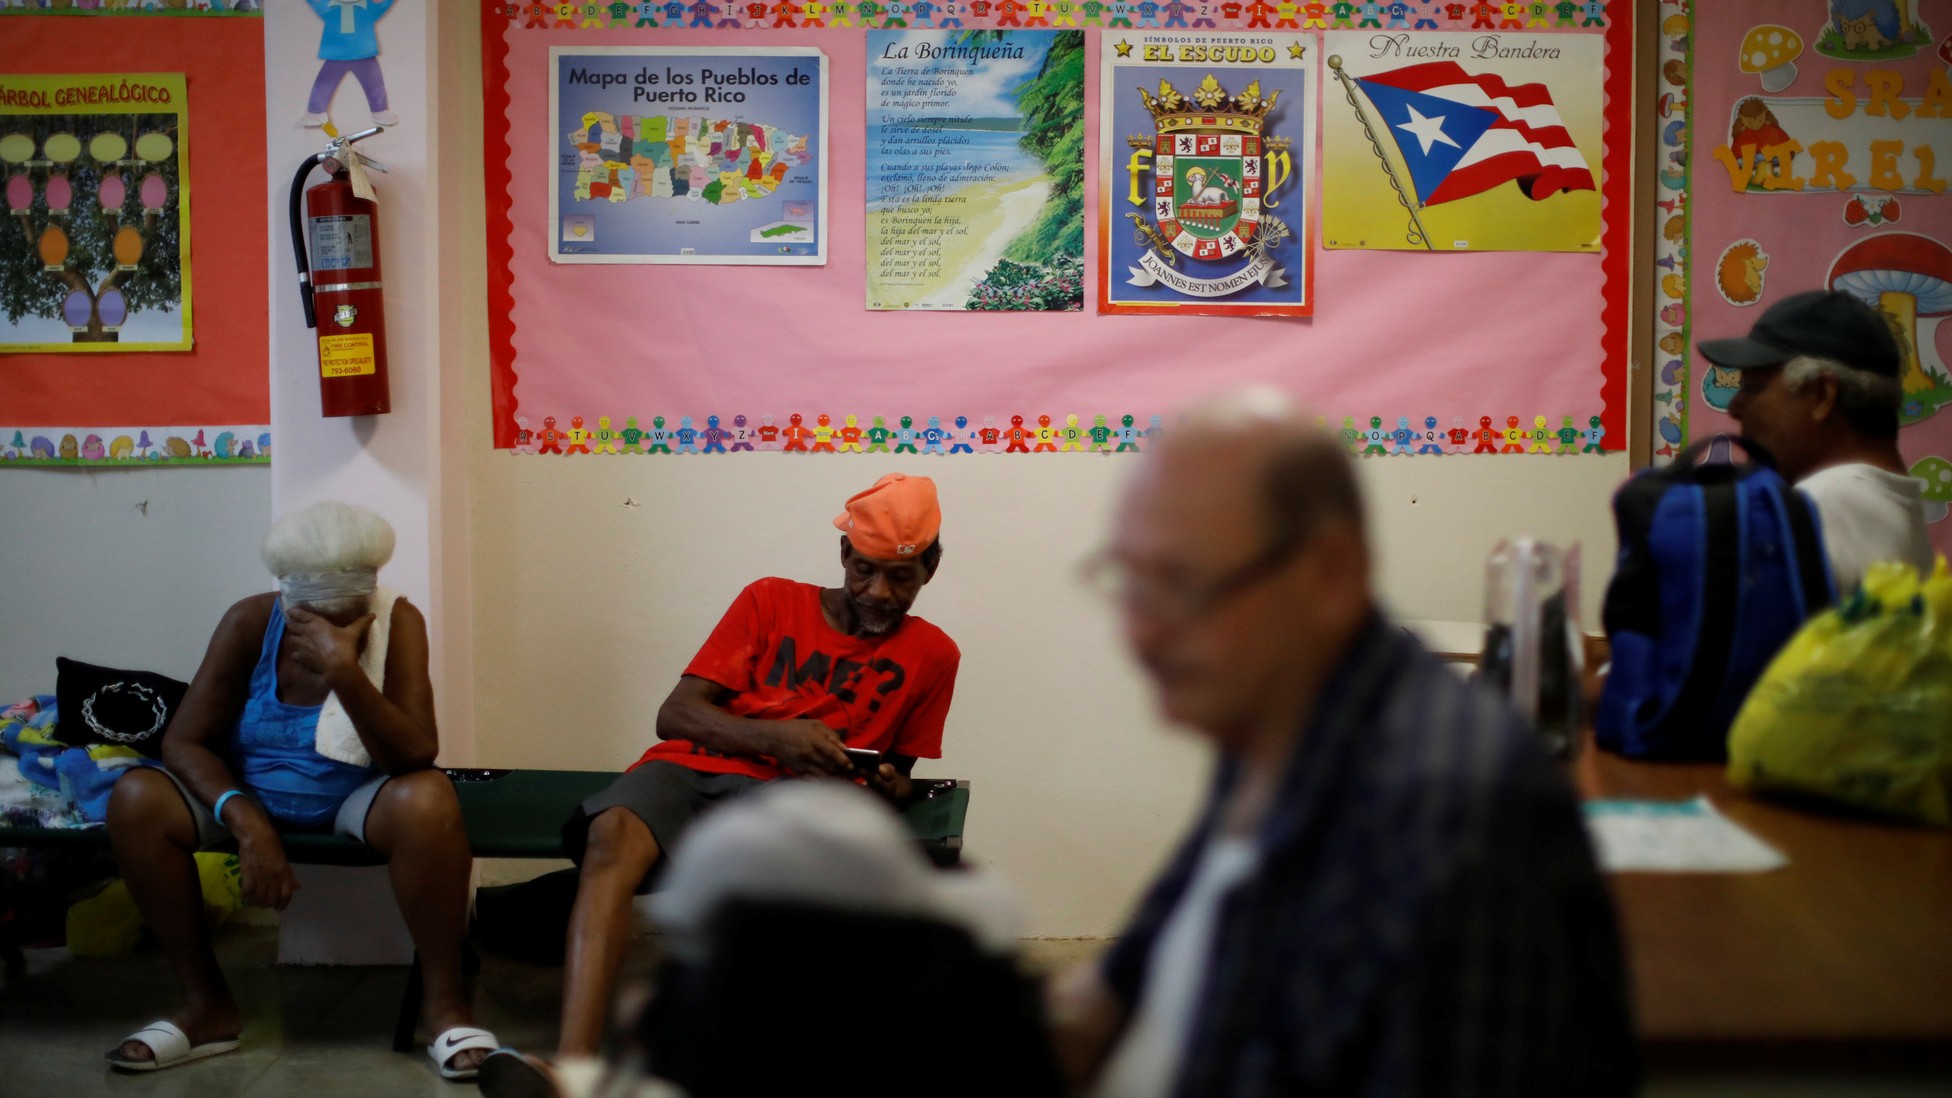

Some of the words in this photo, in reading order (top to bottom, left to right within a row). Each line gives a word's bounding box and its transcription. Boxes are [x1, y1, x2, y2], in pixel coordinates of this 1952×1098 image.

[533, 5, 540, 16] B
[560, 6, 568, 16] C
[588, 6, 595, 16] D
[616, 5, 622, 14] E
[644, 5, 650, 14] F
[670, 5, 678, 14] G
[727, 5, 732, 15] I
[754, 5, 760, 16] J
[782, 5, 789, 14] K
[809, 4, 815, 14] L
[835, 5, 844, 14] M
[864, 4, 871, 13] N
[891, 4, 900, 14] O
[919, 4, 926, 14] P
[947, 4, 955, 15] Q
[978, 4, 985, 14] R
[1004, 4, 1012, 12] S
[1032, 4, 1039, 13] T
[1060, 4, 1068, 13] U
[1088, 4, 1096, 13] V
[1115, 4, 1126, 13] W
[1144, 5, 1151, 14] X
[1172, 6, 1180, 16] Y
[1201, 5, 1208, 15] Z
[1369, 33, 1460, 59] Nuestra
[1470, 34, 1561, 60] Bandera
[882, 42, 909, 60] La
[914, 42, 1025, 66] Borinqueña
[1143, 44, 1174, 62] EL
[1178, 44, 1276, 62] ESCUDO
[880, 67, 892, 75] La
[895, 66, 920, 76] Tierra
[920, 66, 930, 75] de
[931, 66, 974, 77] Borinquen
[568, 68, 627, 90] Mapa
[634, 67, 659, 85] de
[666, 67, 694, 86] los
[701, 67, 778, 86] Pueblos
[784, 67, 811, 86] de
[880, 77, 904, 86] donde
[906, 77, 917, 86] he
[918, 77, 944, 86] nacido
[54, 78, 172, 106] GENEALÓGICO
[634, 86, 698, 103] Puerto
[704, 86, 746, 104] Rico
[928, 88, 957, 98] florido
[880, 98, 890, 106] de
[882, 114, 895, 124] Un
[896, 114, 915, 124] cielo
[918, 116, 946, 126] siempre
[880, 124, 889, 134] le
[890, 126, 908, 134] sirve
[910, 124, 920, 134] de
[922, 124, 943, 134] dosel
[880, 138, 886, 146] y
[888, 136, 904, 144] dan
[904, 136, 936, 144] arrullos
[880, 146, 892, 155] las
[894, 146, 910, 155] olas
[880, 162, 912, 171] Cuando
[934, 162, 962, 174] playas
[917, 172, 937, 181] lleno
[938, 172, 948, 181] de
[912, 194, 920, 203] la
[922, 194, 942, 203] linda
[944, 195, 968, 203] tierra
[880, 206, 894, 216] que
[896, 205, 920, 214] busco
[890, 216, 932, 226] Borinquen
[934, 216, 942, 224] la
[880, 226, 889, 235] la
[890, 226, 906, 238] hija
[907, 226, 922, 235] del
[938, 229, 945, 238] y
[946, 226, 955, 235] el
[880, 237, 894, 245] del
[911, 239, 918, 248] y
[918, 237, 928, 245] el
[880, 248, 894, 256] del
[911, 250, 918, 259] y
[918, 248, 928, 256] el
[880, 258, 894, 266] del
[911, 260, 918, 269] y
[918, 258, 928, 266] el
[880, 268, 894, 277] del
[911, 271, 918, 279] y
[918, 268, 928, 277] el
[1142, 256, 1187, 291] JOANNES
[1188, 282, 1206, 293] EST
[1208, 275, 1248, 293] NOMEN
[1248, 255, 1270, 278] EJUS
[331, 366, 362, 374] 793-6060
[654, 432, 664, 440] W
[738, 430, 745, 440] Z
[764, 635, 906, 713] ME?
